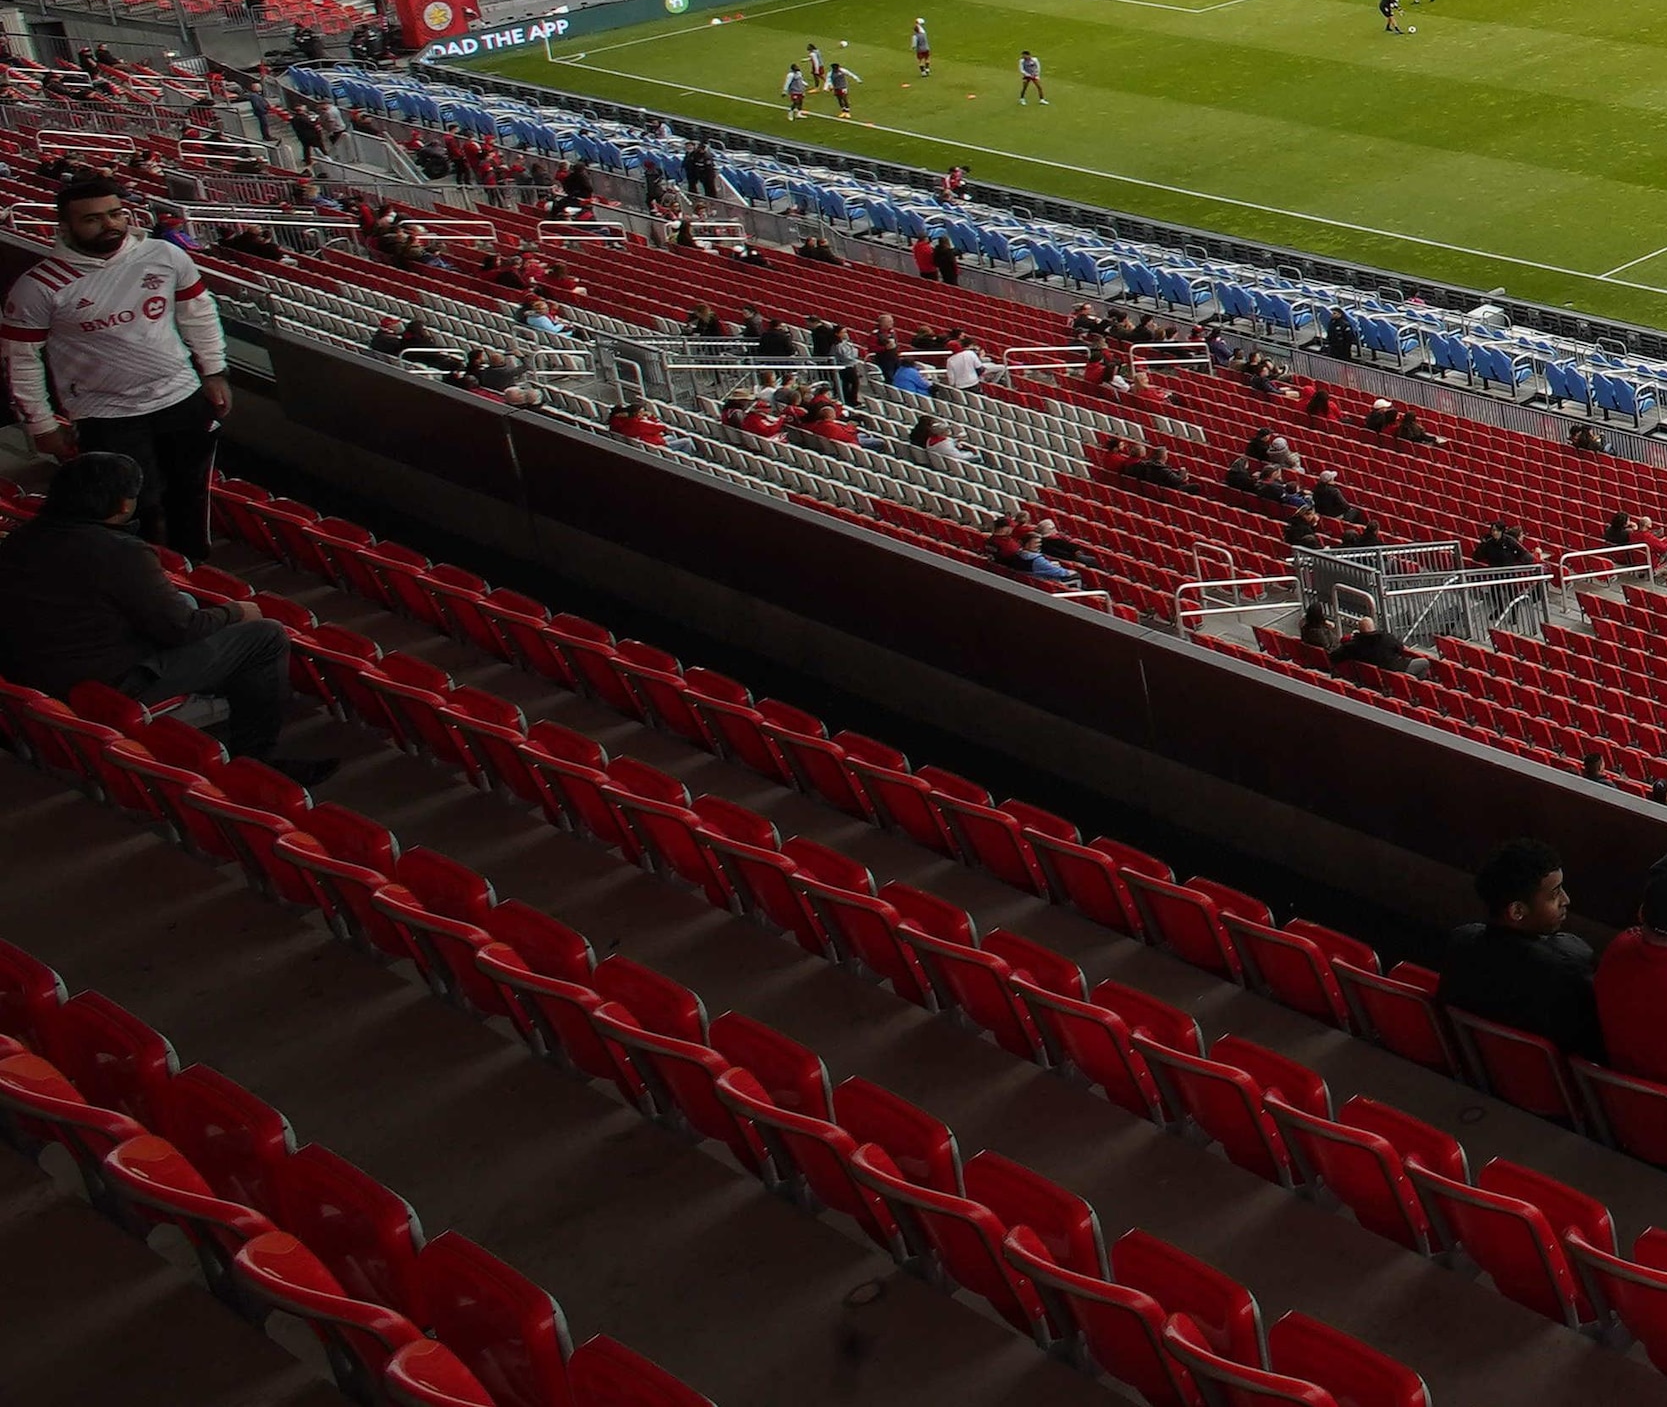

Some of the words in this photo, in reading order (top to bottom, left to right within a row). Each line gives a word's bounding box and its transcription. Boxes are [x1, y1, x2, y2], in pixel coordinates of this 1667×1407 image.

[481, 27, 525, 50] THE
[530, 19, 570, 42] APP
[80, 310, 136, 333] BMO
